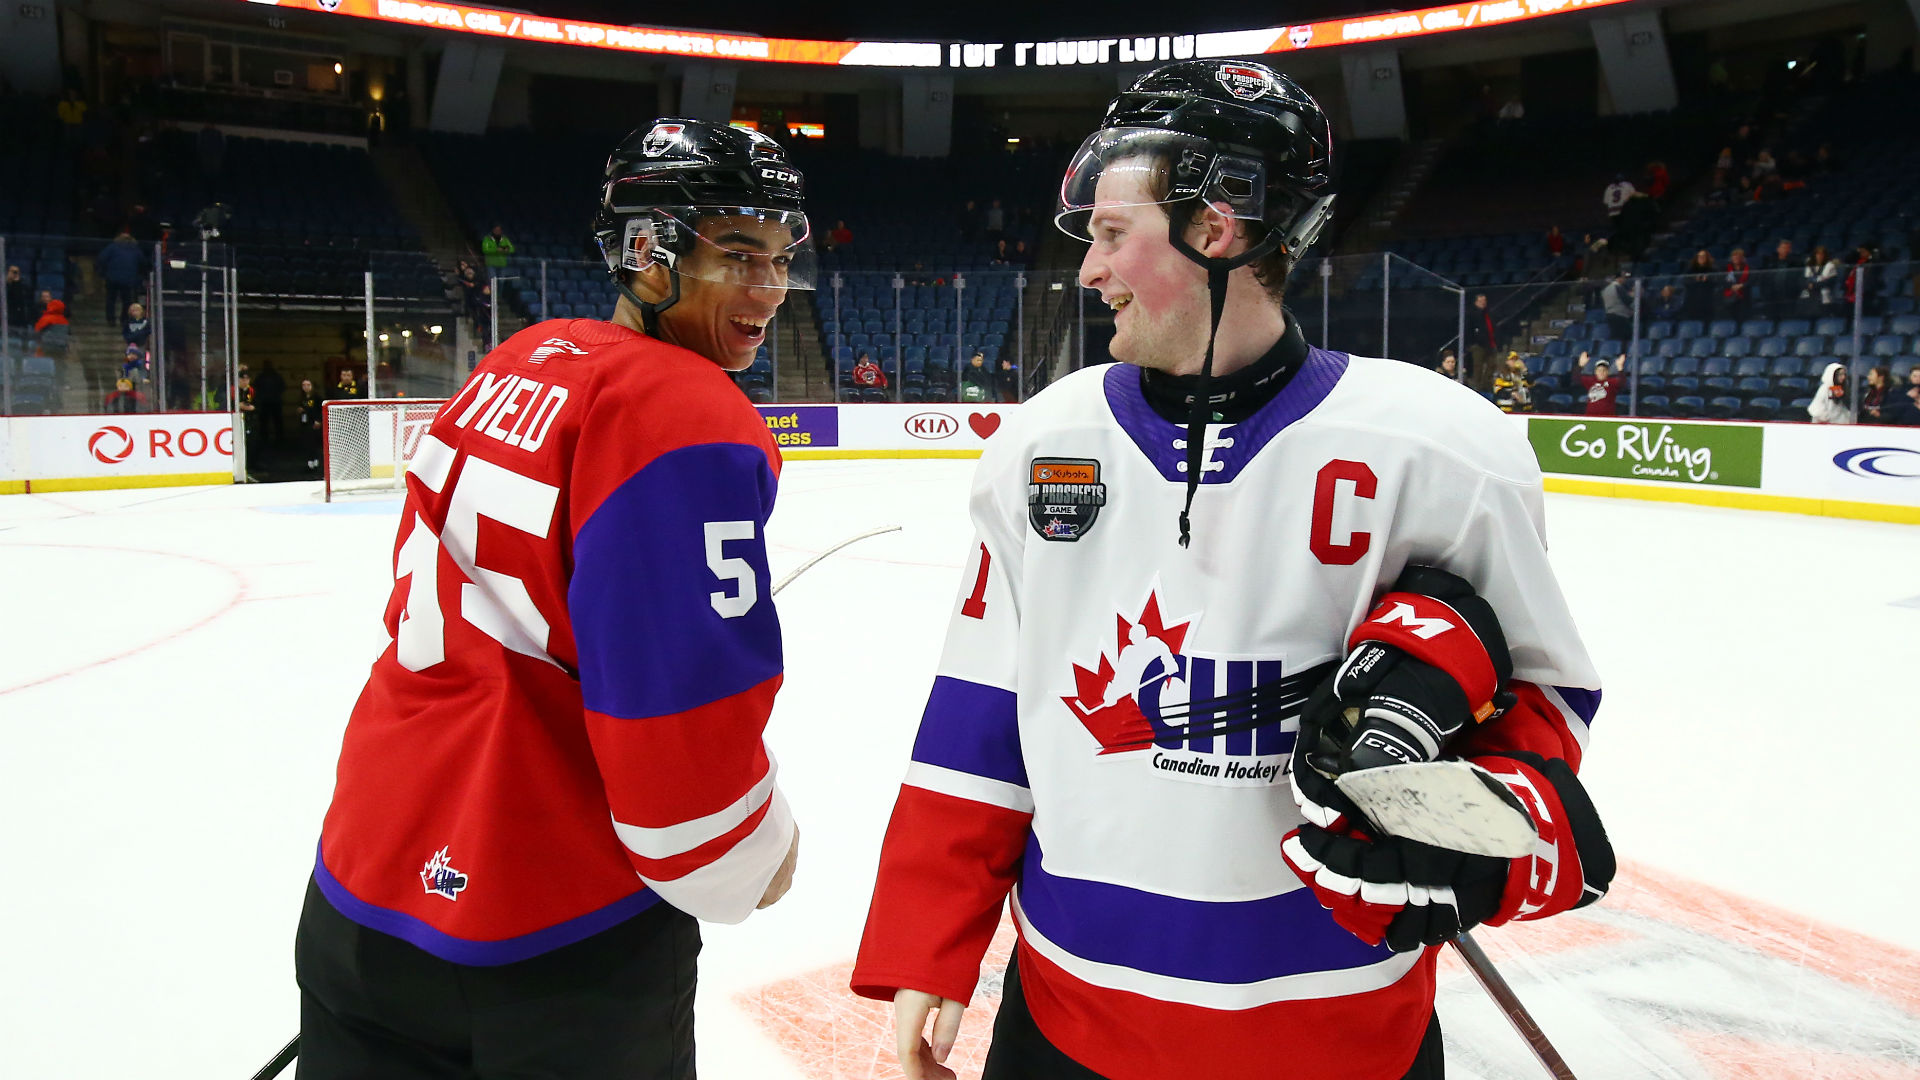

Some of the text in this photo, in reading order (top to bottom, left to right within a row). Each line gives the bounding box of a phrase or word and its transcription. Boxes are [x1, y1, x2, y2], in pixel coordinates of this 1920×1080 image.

[378, 0, 463, 27] KUBOTA
[565, 24, 605, 43] TOP
[606, 29, 713, 54] PROSPECTS
[715, 38, 769, 58] GAME
[1343, 15, 1422, 40] KUBOTA
[1218, 73, 1231, 81] TOP
[761, 168, 798, 184] CCM
[914, 419, 950, 434] KIA
[1560, 424, 1712, 482] Go RVing
[1053, 469, 1089, 480] Kubota
[1632, 463, 1680, 478] Canada
[1042, 484, 1104, 505] PROSPECTS
[1049, 506, 1072, 514] GAME
[1309, 459, 1378, 565] C
[703, 520, 757, 619] 5
[1347, 647, 1380, 679] TACKS
[1138, 654, 1300, 756] CHL
[1152, 752, 1220, 778] Canadian
[1224, 760, 1281, 783] Hockey
